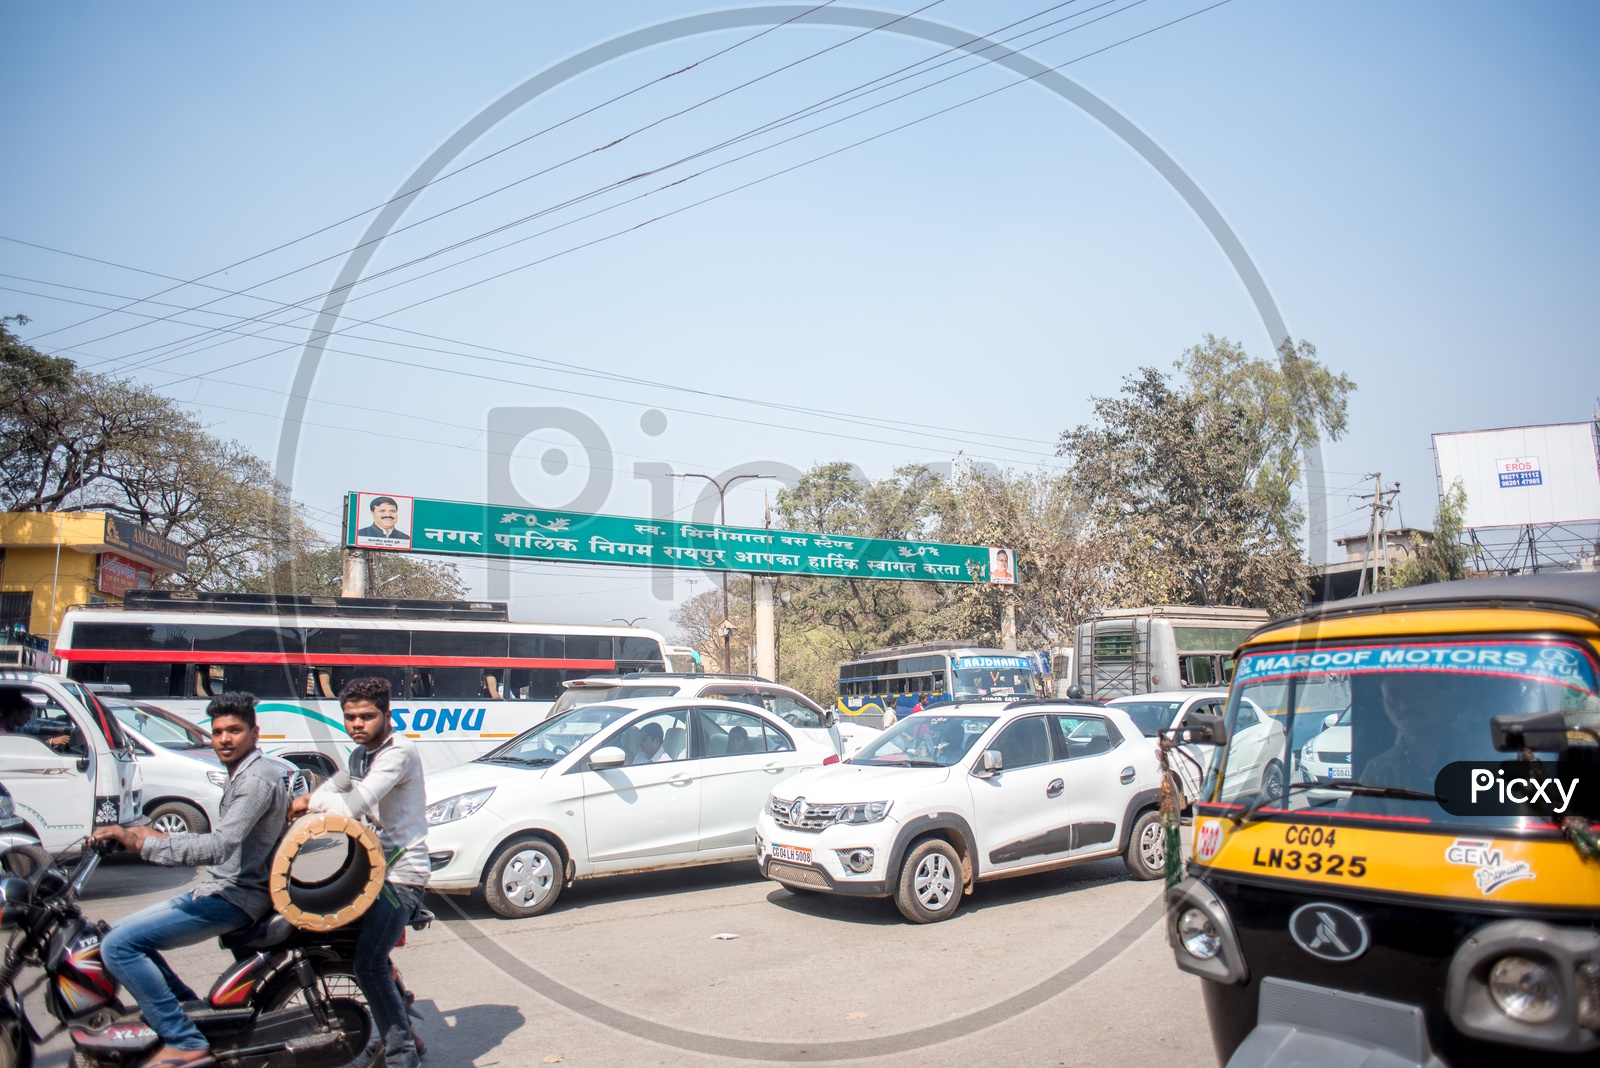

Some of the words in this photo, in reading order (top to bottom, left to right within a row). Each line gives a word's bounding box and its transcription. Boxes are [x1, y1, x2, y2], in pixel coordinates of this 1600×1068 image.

[1505, 462, 1532, 471] EROS
[132, 528, 165, 553] AMAZING
[165, 541, 186, 562] TOURS
[634, 524, 666, 536] स्व.
[680, 525, 774, 544] मिनीमाता
[780, 536, 808, 547] बस
[424, 528, 483, 546] नगर
[495, 530, 579, 552] पालिक
[588, 536, 654, 557] निगम
[662, 546, 726, 566] रायपुर
[734, 551, 800, 567] आपका
[808, 552, 859, 571] हार्दिक
[867, 560, 916, 573] स्वागत
[923, 563, 960, 576] करता
[963, 658, 1020, 668] RAJDHANI
[1254, 651, 1372, 671] MAROOF
[1379, 649, 1527, 666] MOTORS
[1531, 660, 1583, 680] ATUL
[391, 708, 487, 735] SONU
[1285, 825, 1336, 848] CG04
[1252, 847, 1368, 878] LN3325
[1448, 847, 1501, 867] GEM
[79, 935, 98, 948] TVS
[112, 1029, 136, 1040] XL
